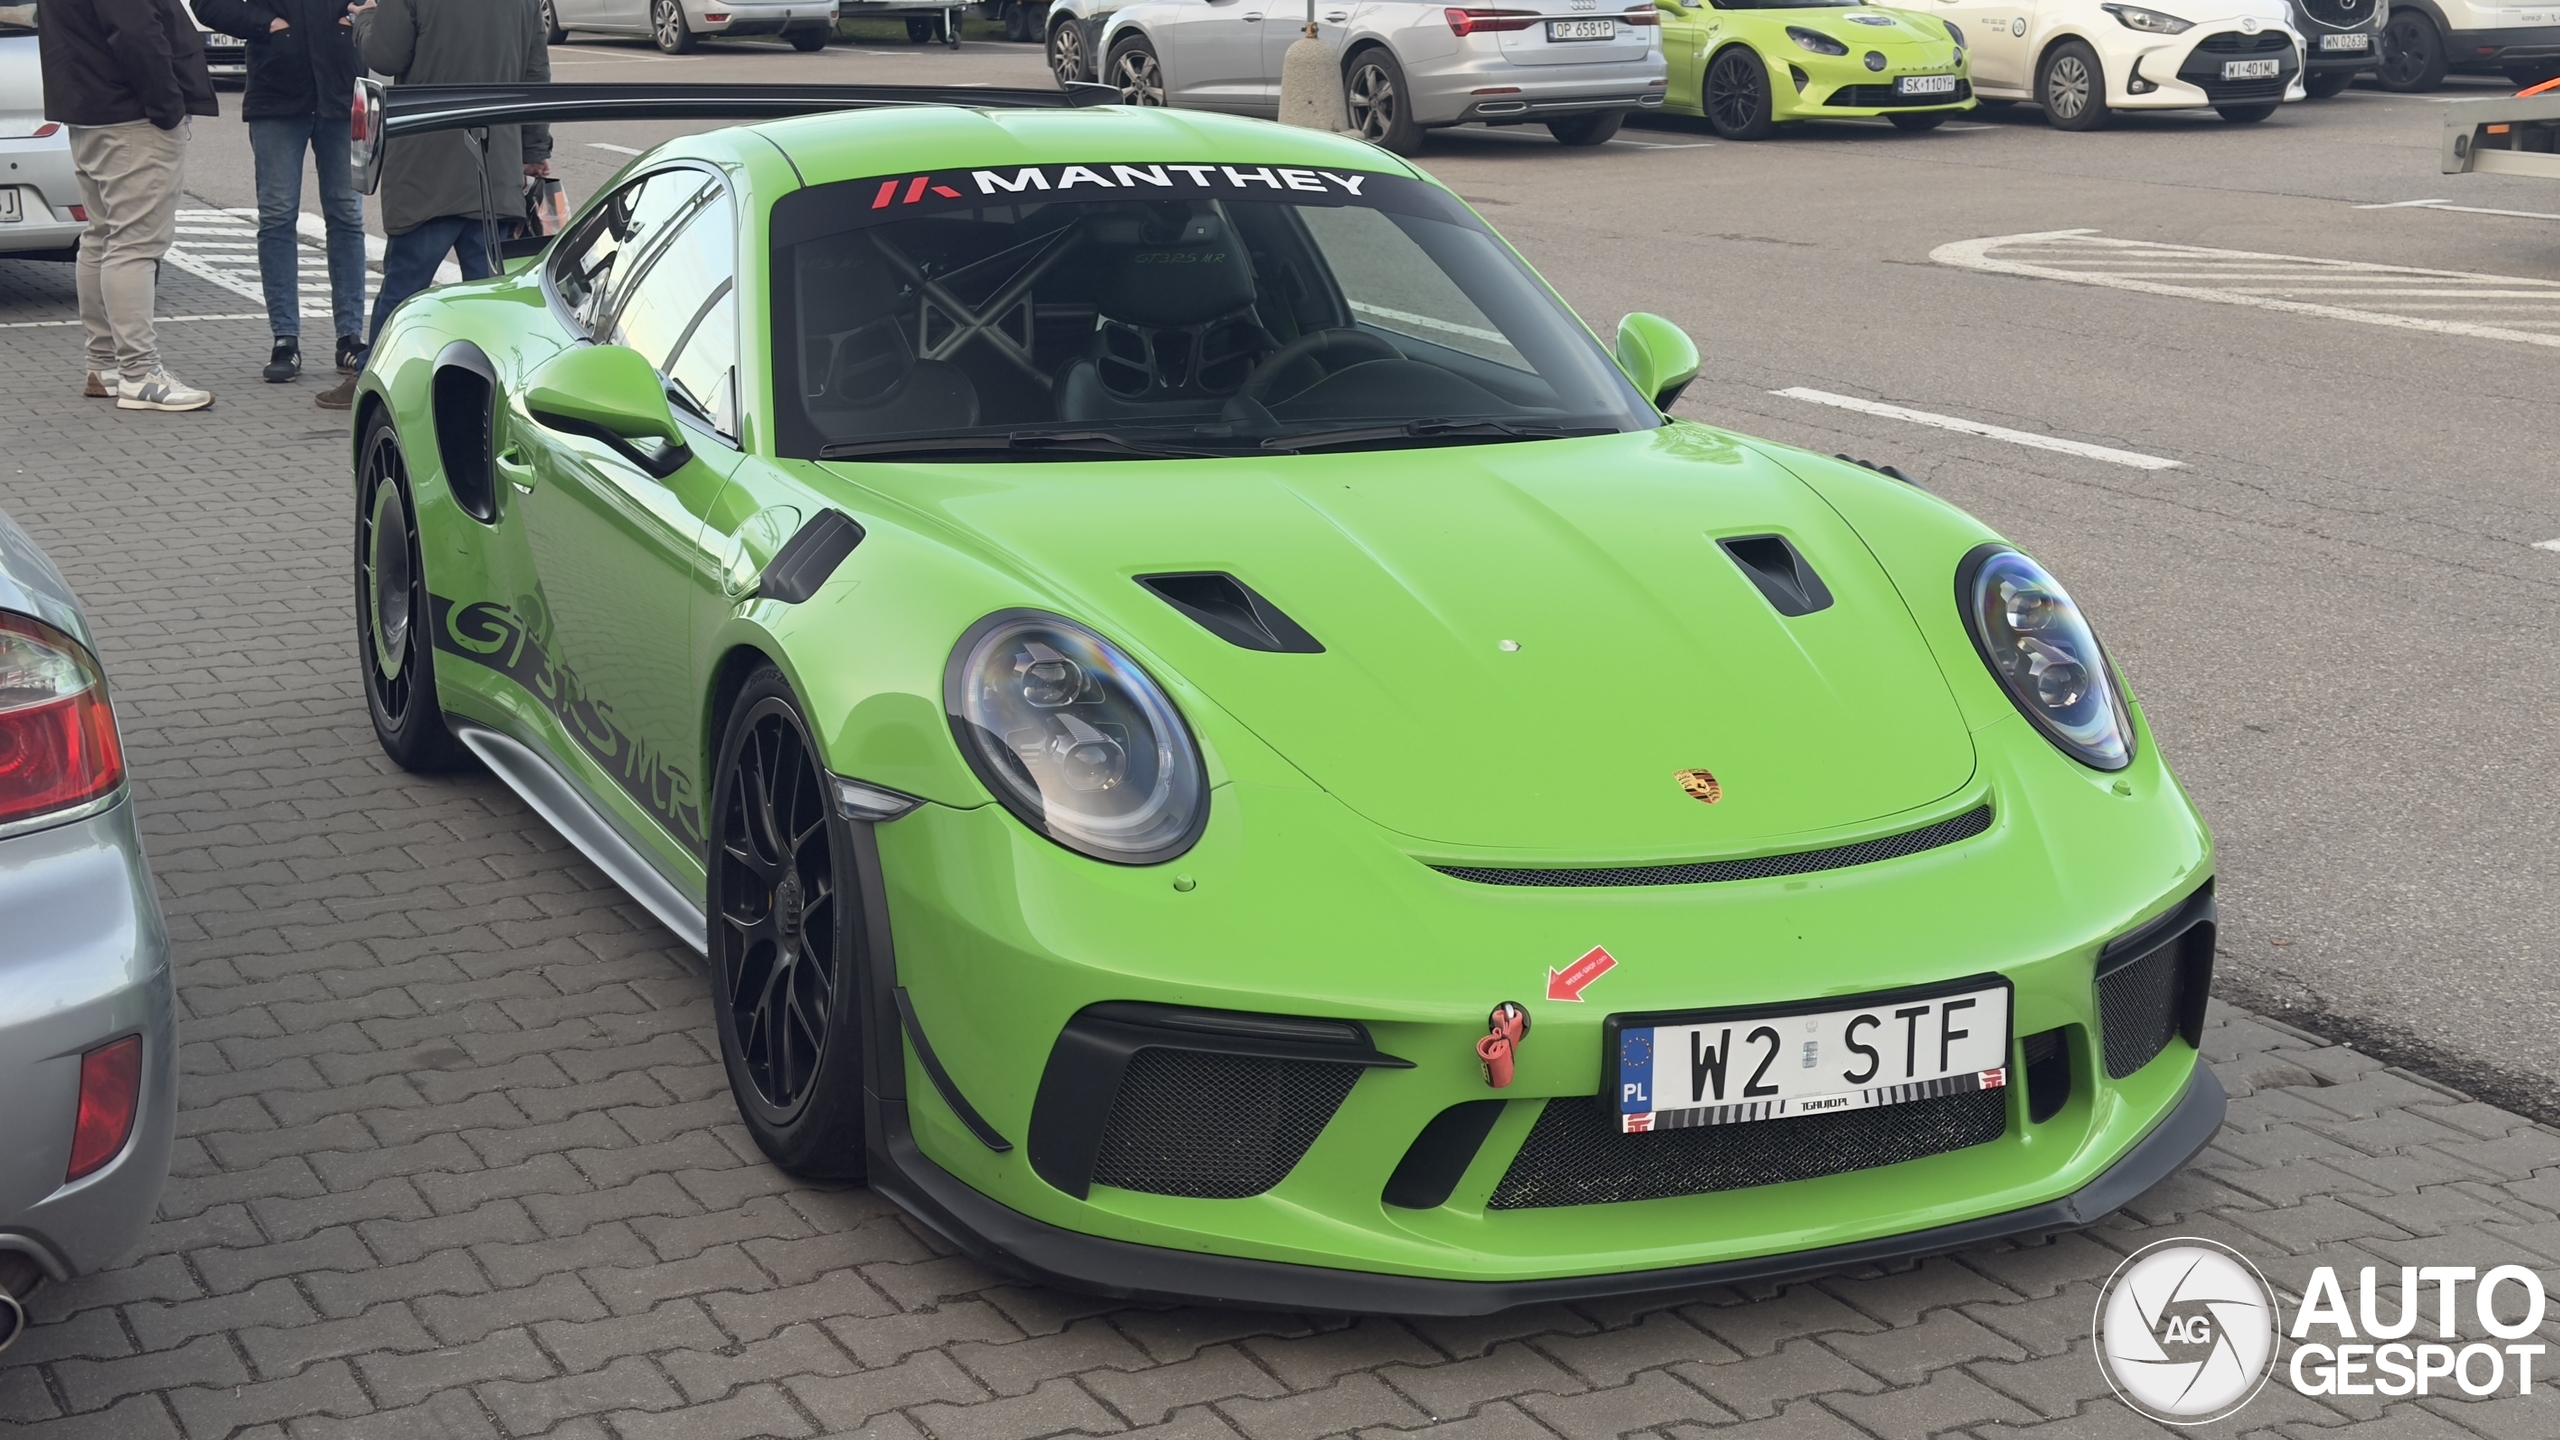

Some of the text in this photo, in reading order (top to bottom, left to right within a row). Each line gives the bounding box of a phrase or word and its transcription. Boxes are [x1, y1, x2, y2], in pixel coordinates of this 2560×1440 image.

[1575, 21, 1611, 37] 6581P
[2325, 35, 2339, 48] WN
[2228, 61, 2276, 77] WI 401ML
[1906, 76, 1954, 92] SK 110YH
[972, 165, 1366, 197] MANTHEY
[1691, 998, 1976, 1102] W2 STF
[1623, 1082, 1648, 1103] PL
